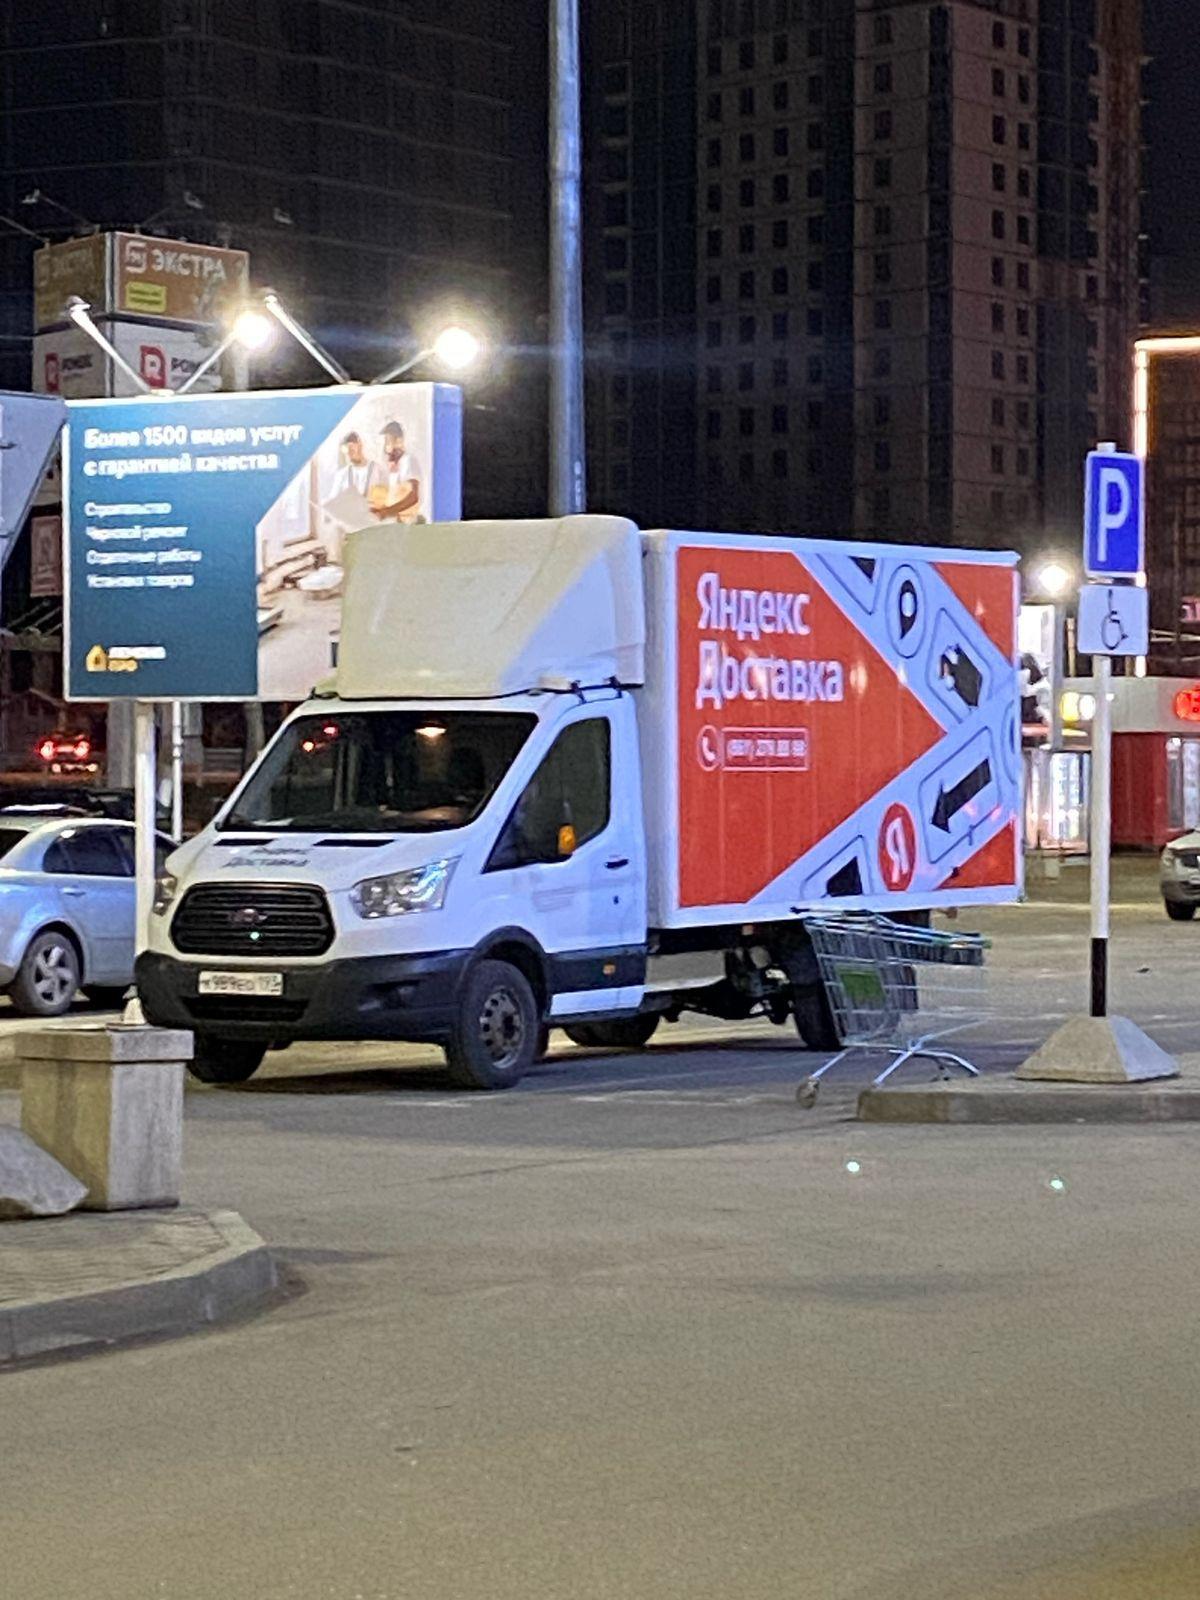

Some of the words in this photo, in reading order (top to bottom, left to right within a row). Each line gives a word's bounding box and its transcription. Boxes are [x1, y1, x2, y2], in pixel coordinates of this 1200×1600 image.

[152, 249, 226, 280] ЭКСТРА
[84, 428, 140, 449] Более
[143, 425, 188, 446] 1500
[190, 427, 247, 446] видов
[249, 424, 303, 446] услуг
[83, 460, 98, 477] с
[98, 452, 192, 480] гарантией
[195, 454, 278, 473] качества
[1097, 467, 1131, 562] P
[696, 572, 811, 641] Яндекс
[695, 640, 844, 710] Доставка
